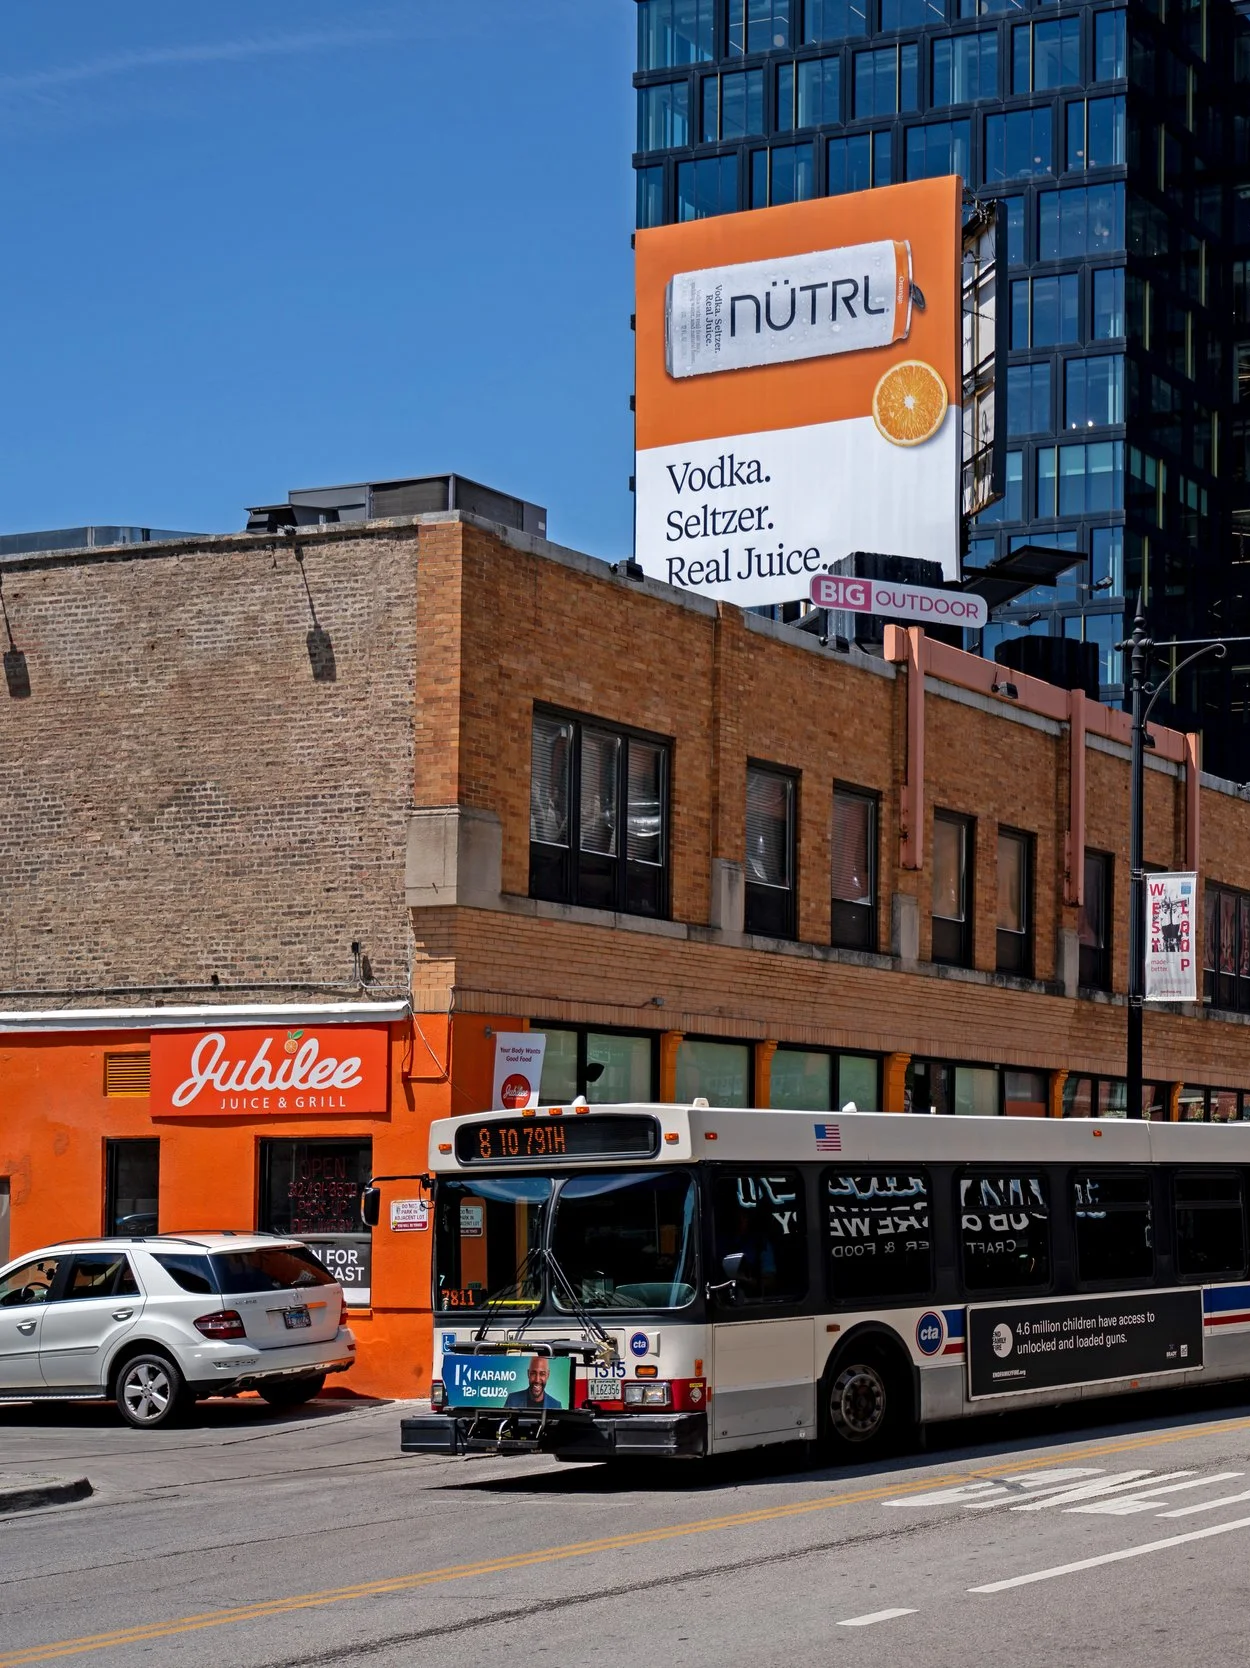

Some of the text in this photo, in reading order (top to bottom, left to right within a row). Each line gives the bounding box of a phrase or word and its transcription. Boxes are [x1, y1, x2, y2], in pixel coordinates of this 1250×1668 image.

[897, 276, 905, 305] Orange
[705, 294, 713, 347] Real Juice.
[714, 284, 722, 354] Vodka. Seltzer.
[666, 453, 771, 495] Vodka.
[666, 504, 774, 541] Seltzer.
[666, 543, 829, 586] Real Juice.
[819, 580, 979, 619] BIG OUTDOOR
[1149, 883, 1165, 953] WEST
[1180, 900, 1191, 972] LOOP
[512, 1047, 524, 1055] Body
[172, 1032, 363, 1107] Jubilee
[221, 1096, 347, 1110] JUICE & GRILL
[479, 1126, 566, 1158] 8 TO 79TH
[301, 1157, 347, 1179] OPEN
[326, 1250, 358, 1264] FOR
[439, 1274, 445, 1286] 7
[921, 1326, 939, 1340] cta
[1016, 1312, 1155, 1336] 4.6 million children have access to
[633, 1340, 646, 1348] cta
[1017, 1333, 1128, 1354] unlocked and loaded guns.
[474, 1370, 517, 1381] KARAMO
[594, 1361, 626, 1378] 1315
[463, 1386, 476, 1397] 12p
[596, 1383, 620, 1395] 162356
